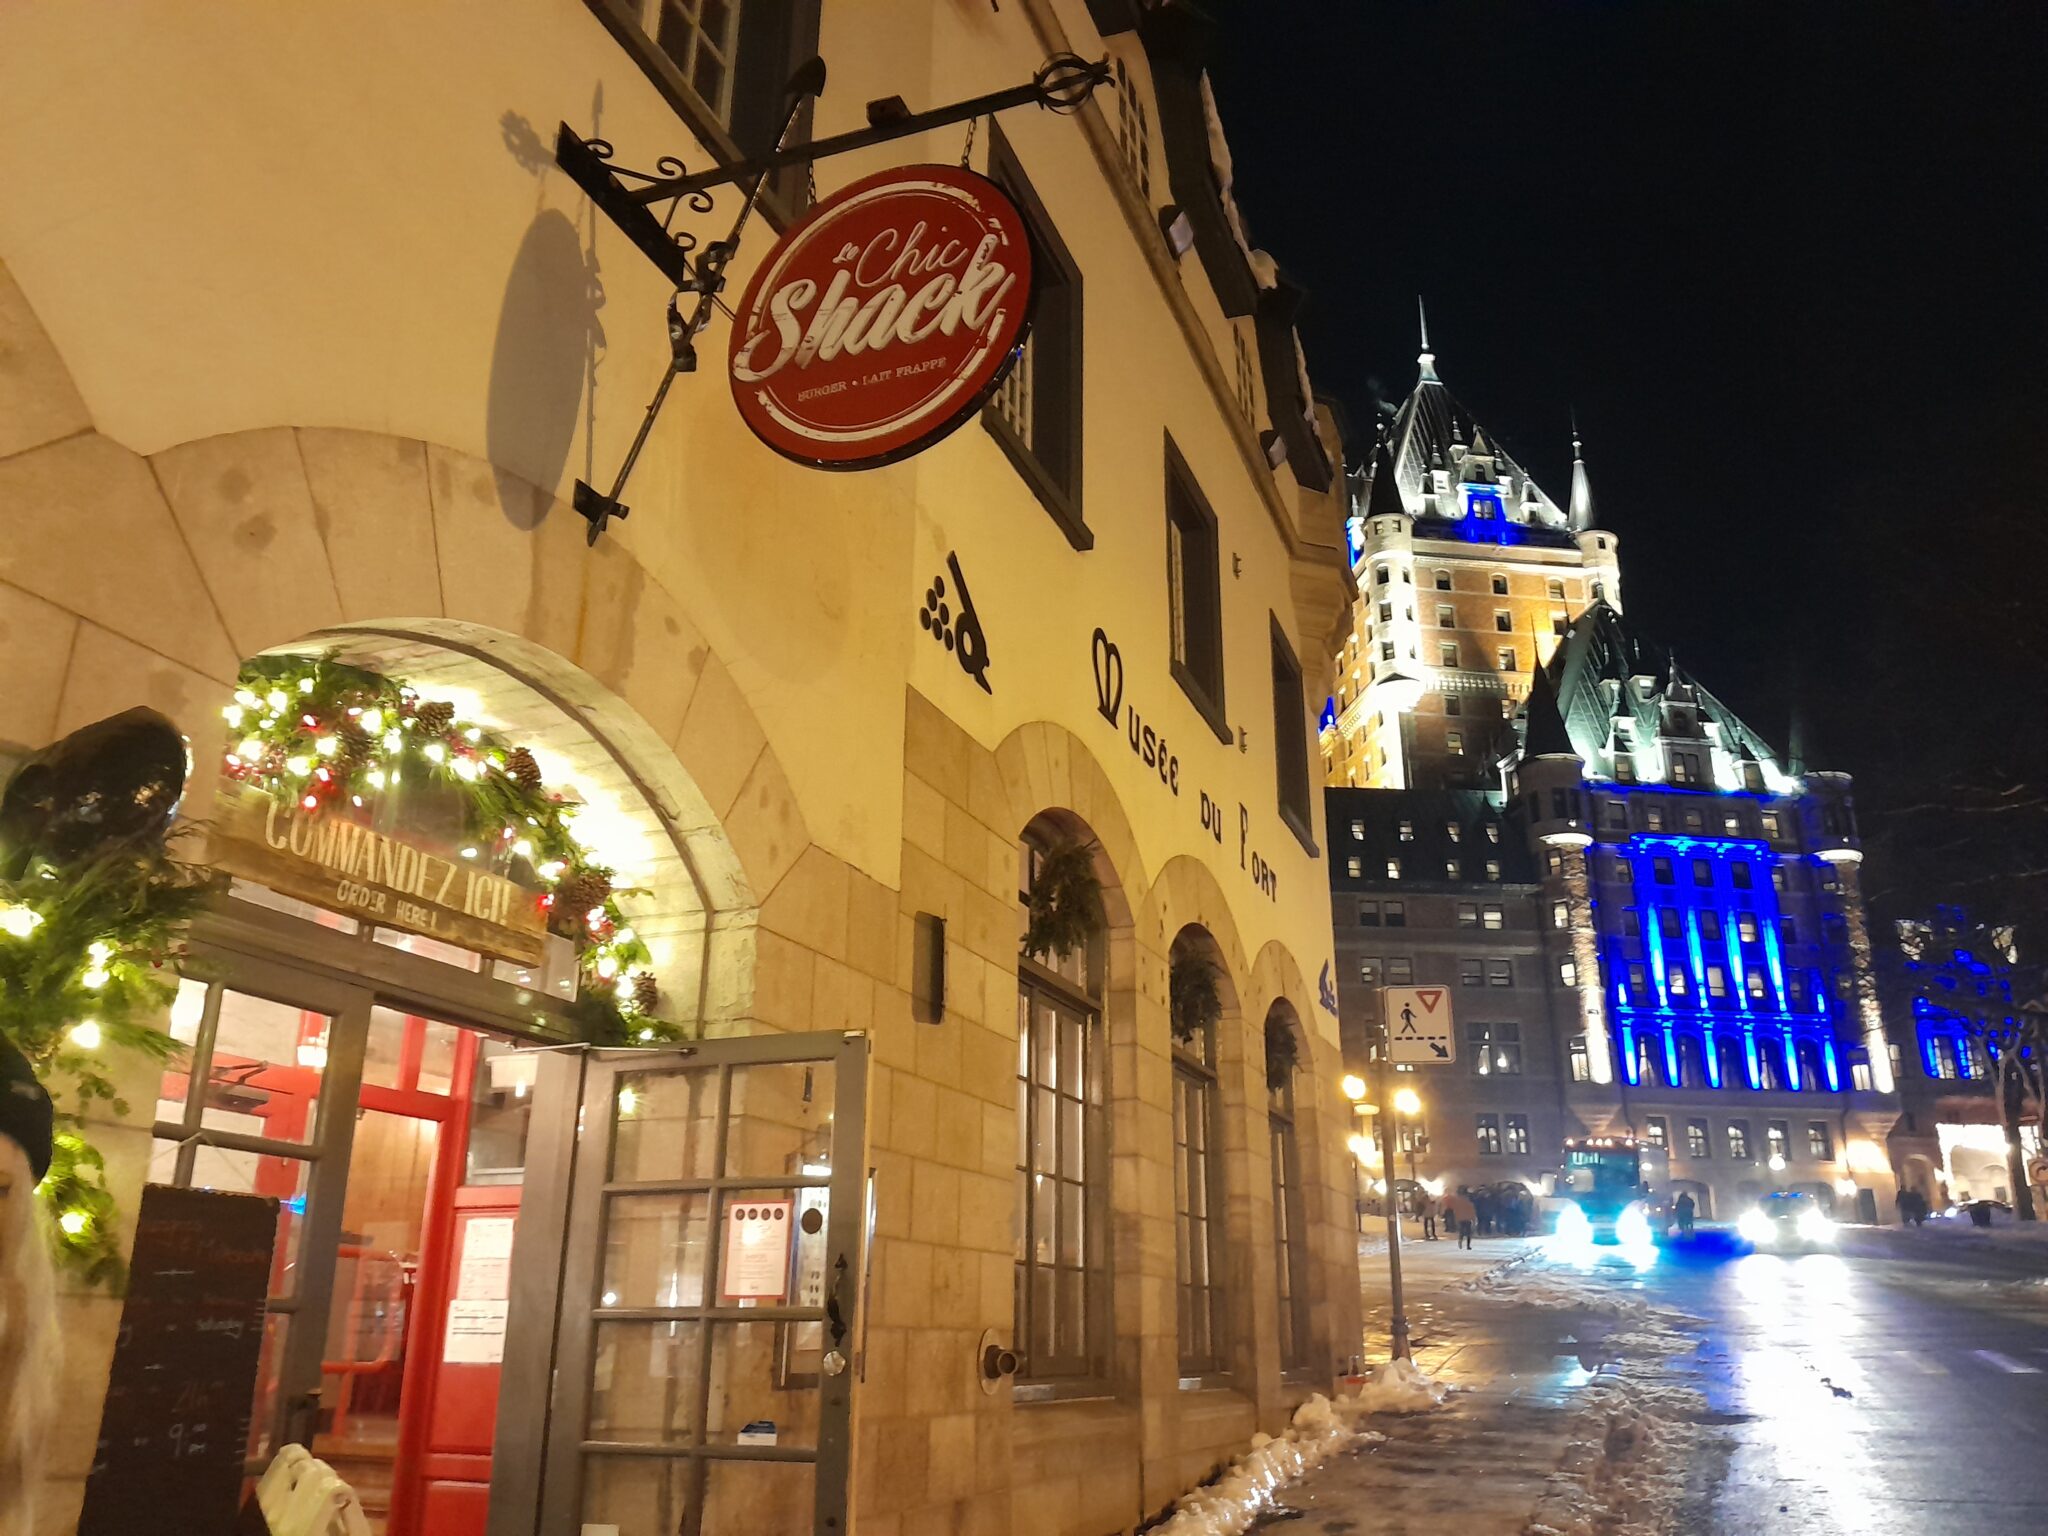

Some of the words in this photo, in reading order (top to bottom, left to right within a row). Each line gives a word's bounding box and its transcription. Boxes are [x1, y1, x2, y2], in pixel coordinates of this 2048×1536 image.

[855, 221, 969, 288] Chic
[733, 233, 1016, 382] Shack
[798, 380, 848, 402] BURGER
[862, 369, 893, 386] LAIT
[265, 799, 458, 910] COMMANDEZ
[337, 880, 386, 914] ORDER
